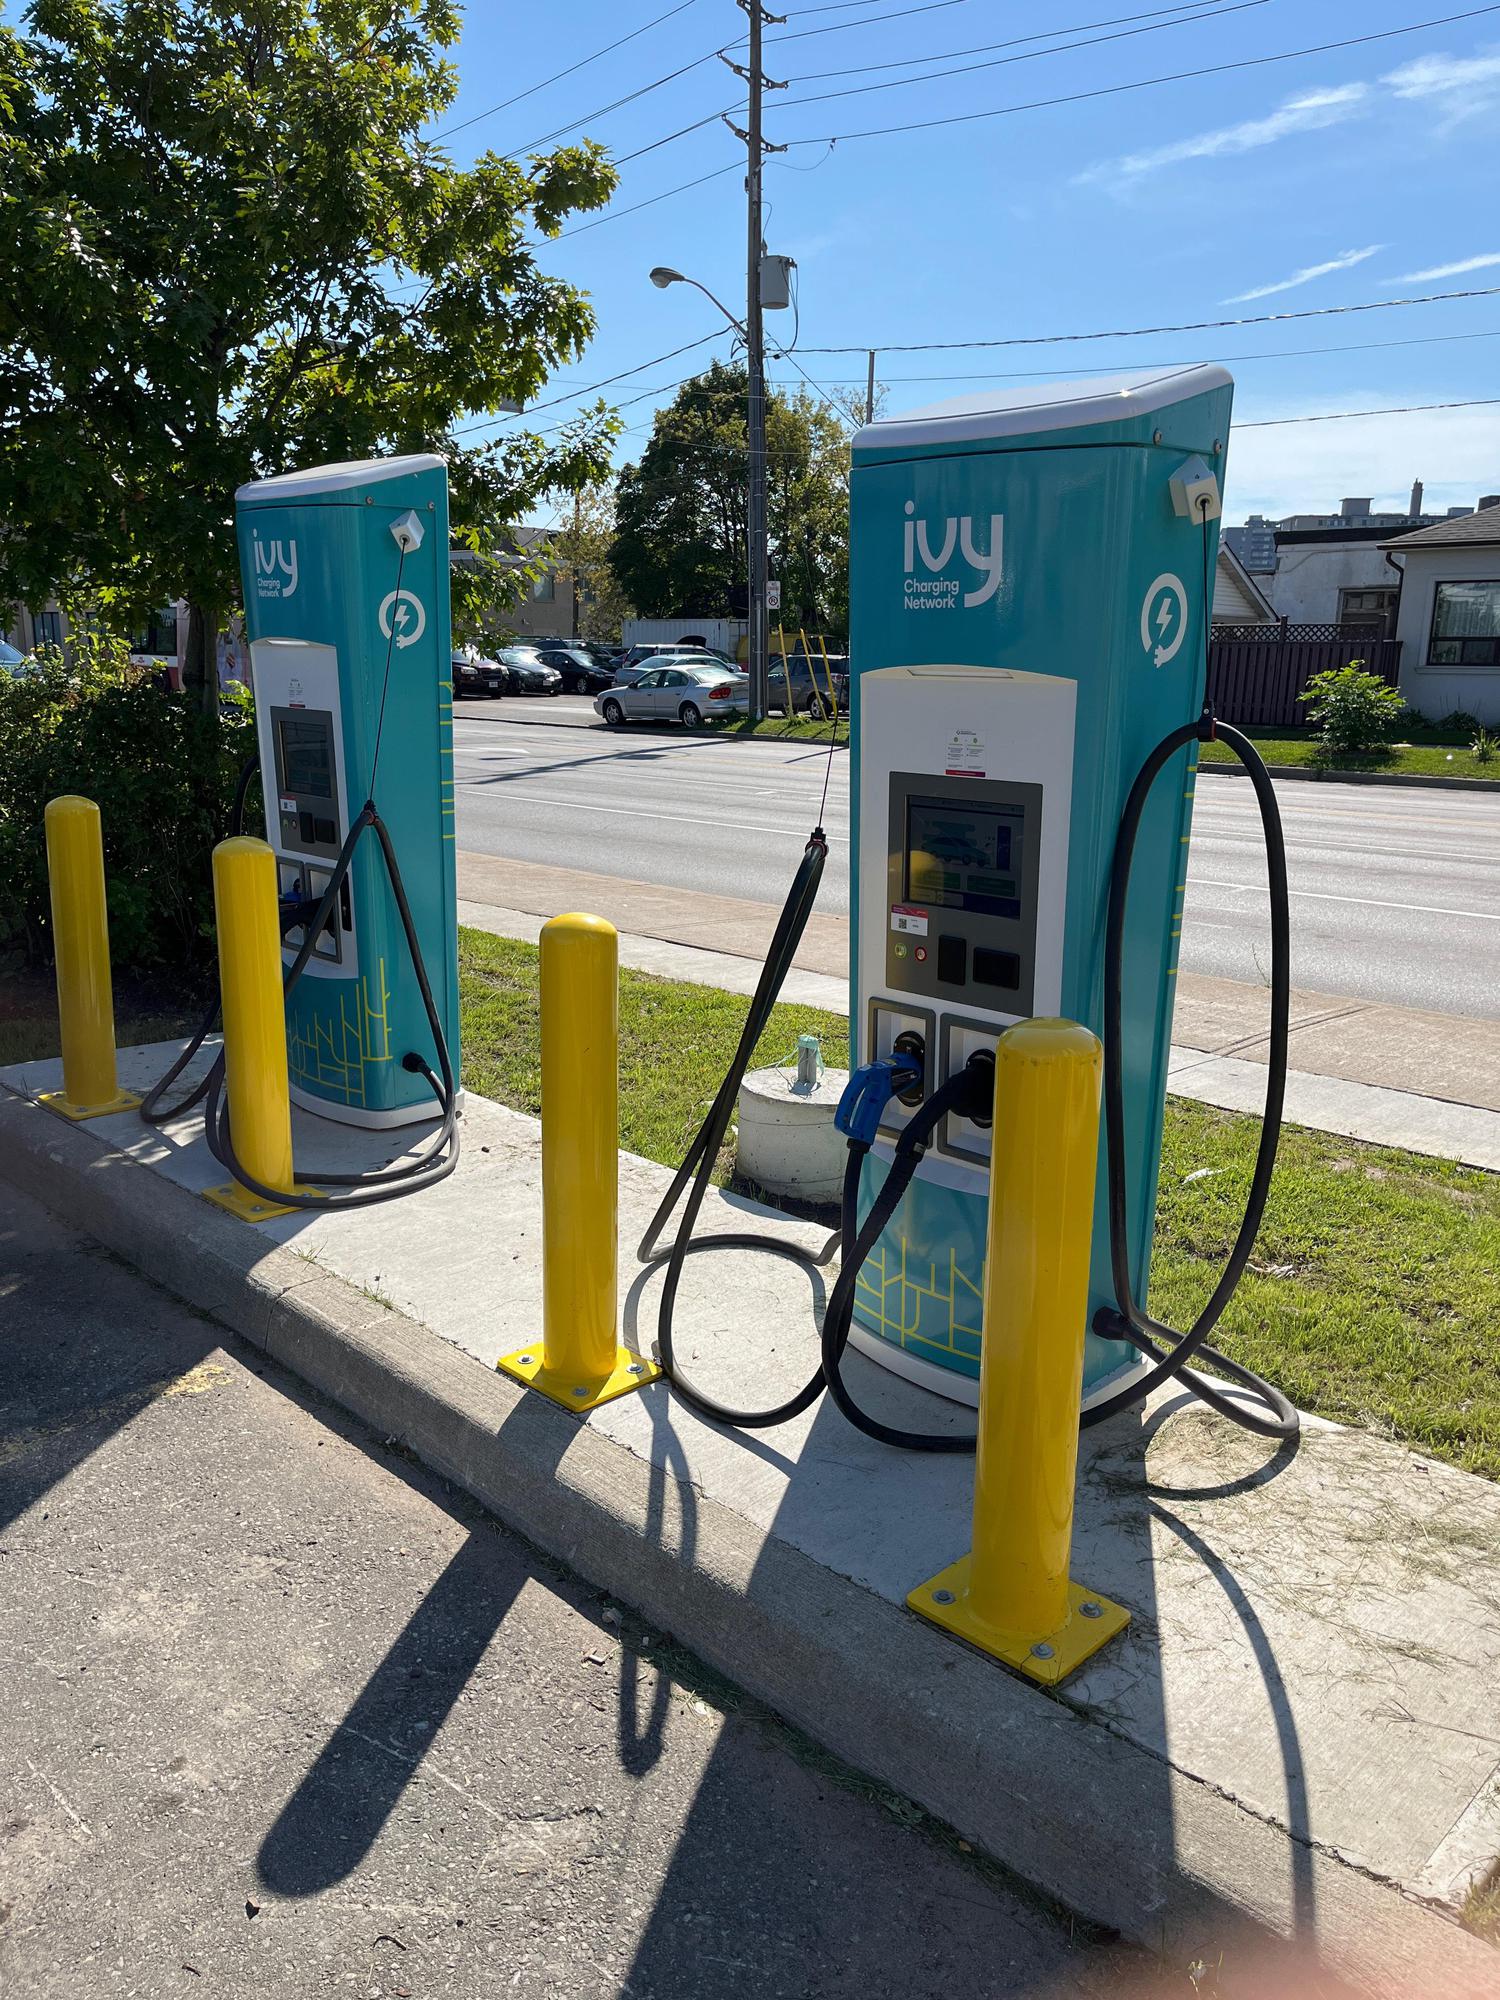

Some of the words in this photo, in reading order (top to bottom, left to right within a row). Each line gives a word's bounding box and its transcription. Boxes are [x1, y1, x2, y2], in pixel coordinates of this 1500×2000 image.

[904, 500, 1004, 608] ivy
[253, 528, 298, 597] ivy
[257, 577, 281, 590] Charging
[904, 577, 960, 594] Charging
[258, 588, 280, 598] Network
[904, 595, 956, 609] Network
